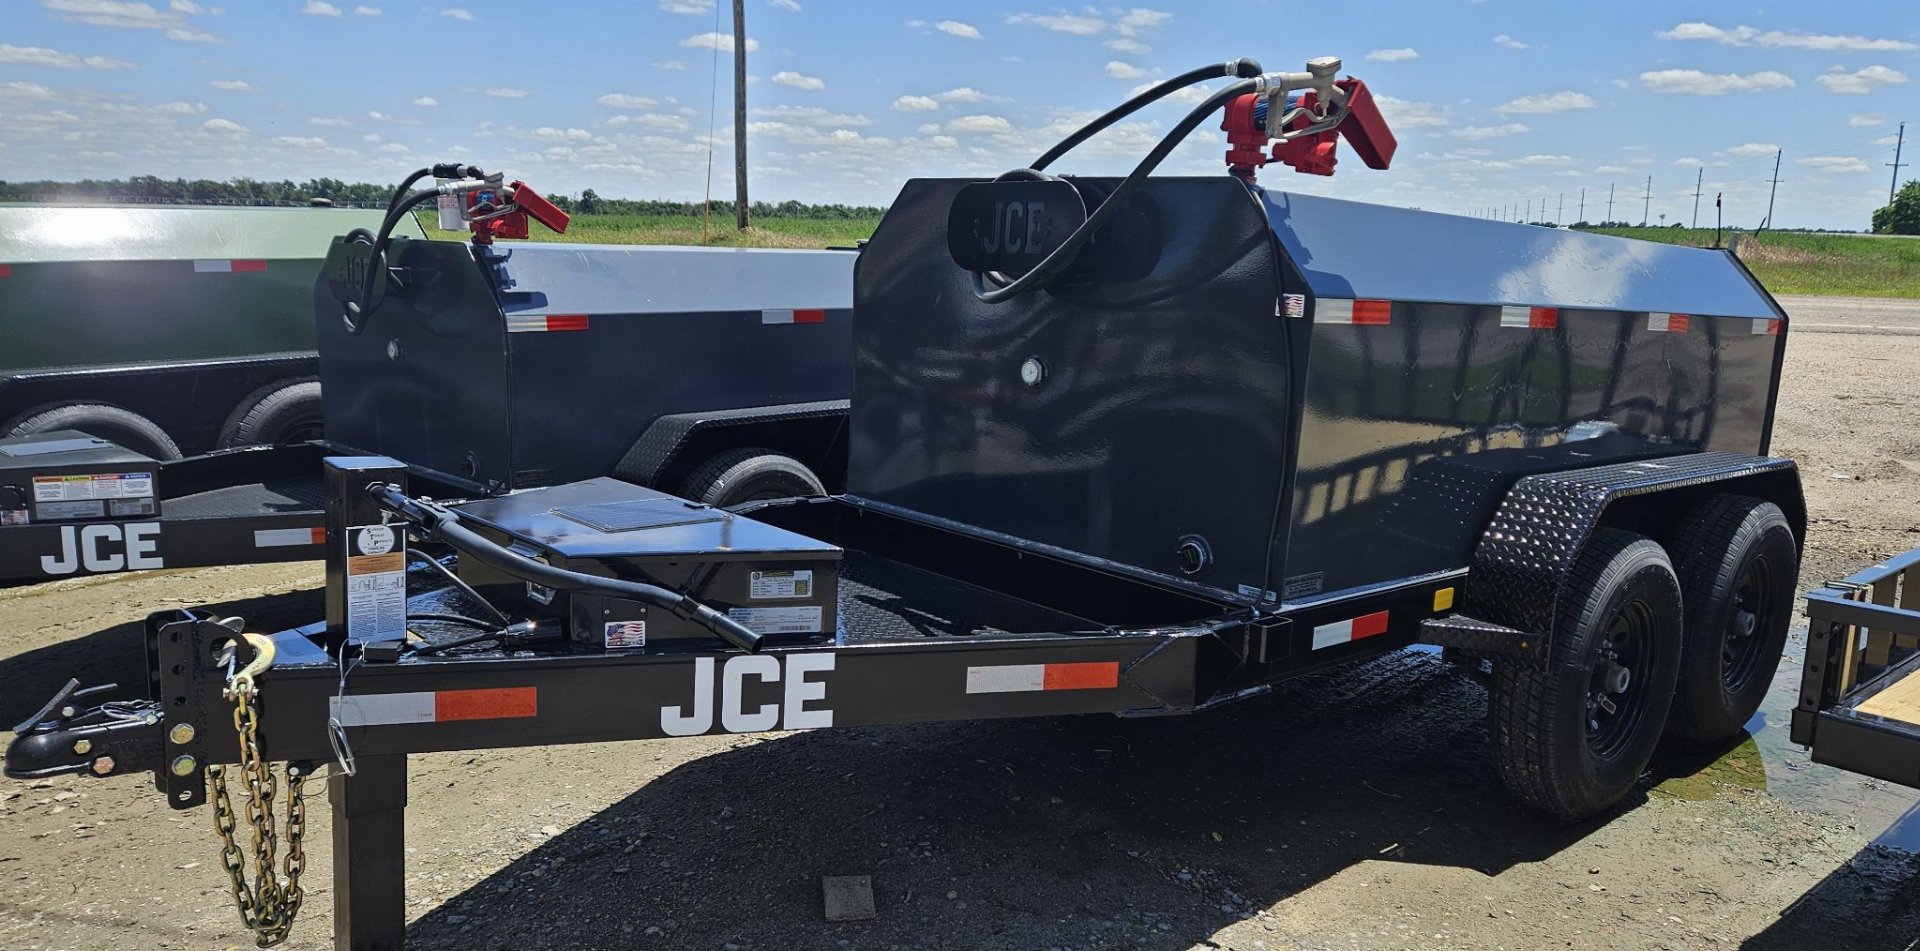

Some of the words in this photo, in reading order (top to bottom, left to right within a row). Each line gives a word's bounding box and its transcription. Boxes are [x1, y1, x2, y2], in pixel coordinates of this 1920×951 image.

[983, 201, 1045, 255] JCE
[41, 523, 163, 574] JCE
[661, 653, 835, 736] JCE
